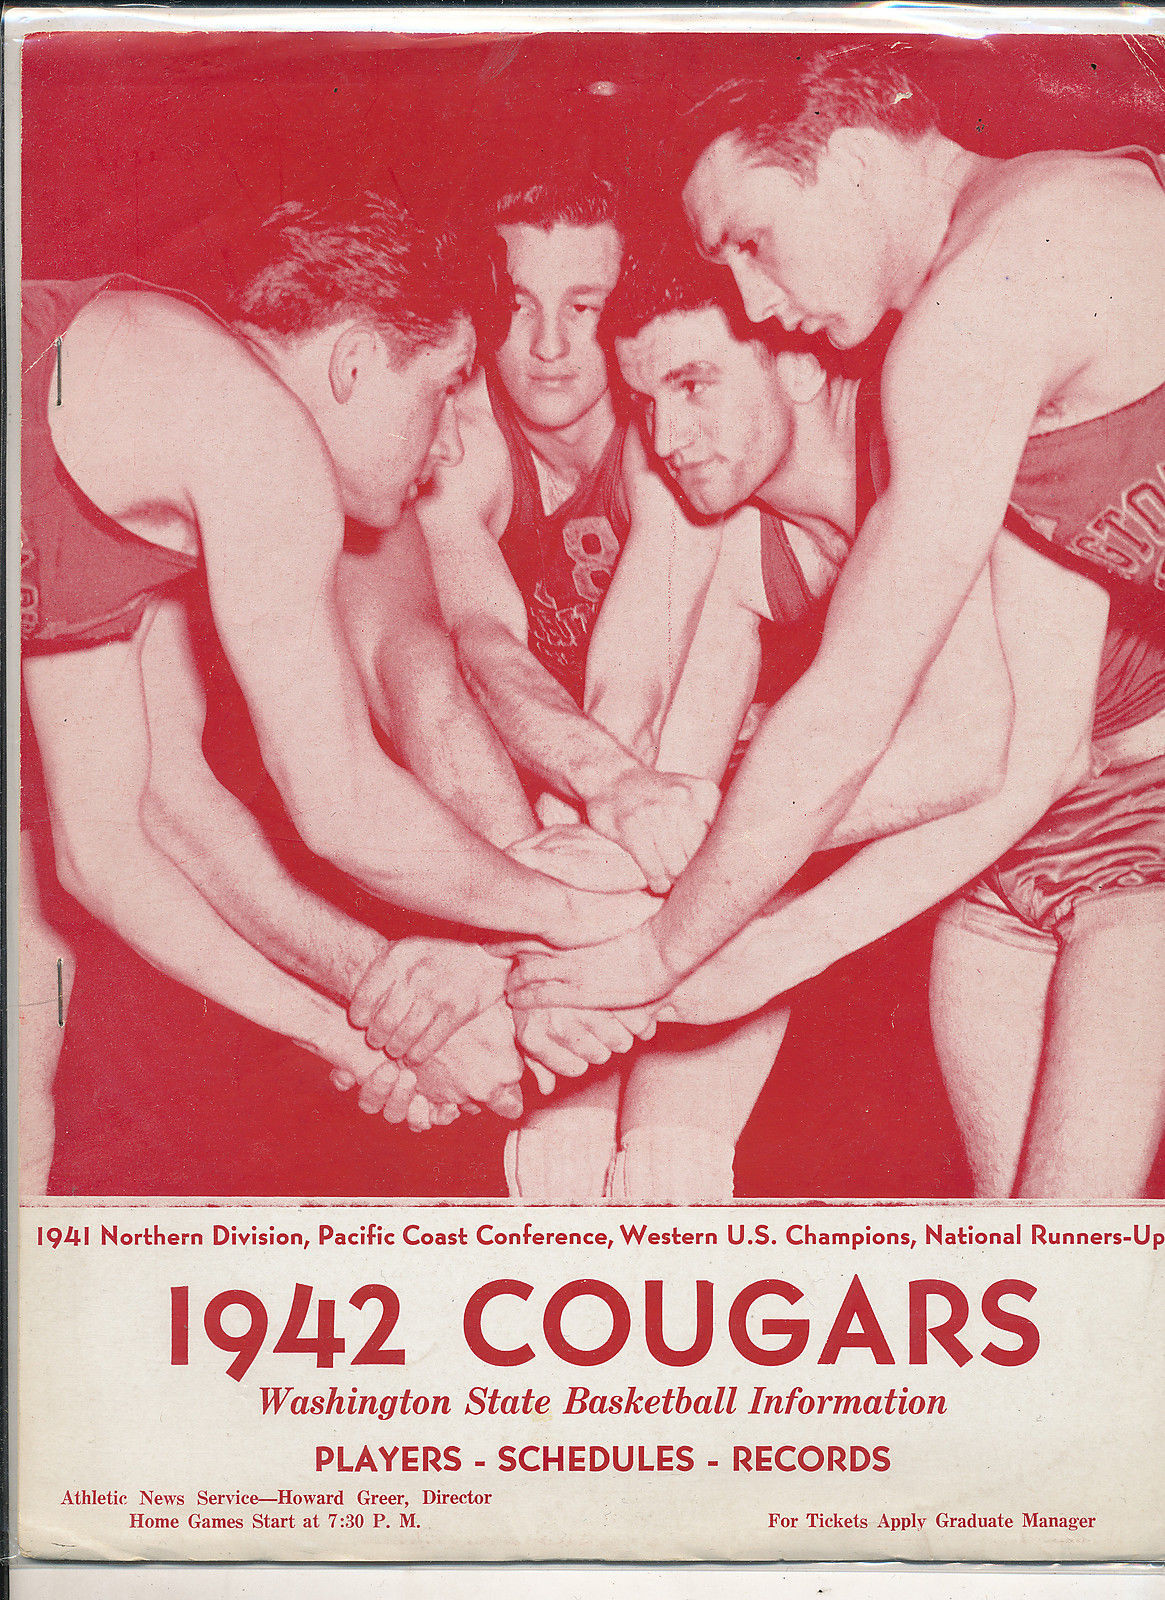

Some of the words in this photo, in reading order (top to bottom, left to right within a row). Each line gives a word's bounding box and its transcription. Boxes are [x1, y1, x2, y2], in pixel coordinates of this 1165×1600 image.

[562, 515, 620, 603] 8
[37, 1225, 90, 1250] 1941
[101, 1223, 204, 1247] Northern
[212, 1224, 311, 1251] Division,
[318, 1223, 396, 1246] Pacific
[402, 1224, 469, 1246] Coast
[476, 1222, 614, 1250] Conference,
[619, 1223, 718, 1246] Western
[727, 1223, 777, 1246] U.S.
[785, 1223, 917, 1251] Champions,
[925, 1223, 1022, 1246] National
[1031, 1223, 1165, 1251] Runners-Up
[170, 1282, 406, 1383] 1942
[463, 1273, 1041, 1369] COUGARS
[259, 1386, 451, 1421] Washington
[464, 1386, 551, 1416] State
[561, 1385, 738, 1415] Basketball
[746, 1386, 948, 1416] Information
[315, 1444, 462, 1473] PLAYERS
[497, 1445, 695, 1473] SCHEDULES
[732, 1445, 892, 1473] RECORDS
[60, 1489, 128, 1506] Athletic
[139, 1489, 185, 1506] News
[356, 1489, 409, 1509] Greer,
[421, 1489, 493, 1505] Director
[128, 1513, 180, 1529] Home
[187, 1513, 244, 1529] Games
[252, 1513, 296, 1529] Start
[302, 1513, 320, 1529] at
[328, 1513, 365, 1529] 7:30
[372, 1512, 391, 1529] P.
[399, 1512, 421, 1529] M.
[767, 1512, 799, 1529] For
[805, 1512, 869, 1529] Tickets
[877, 1512, 927, 1532] Apply
[935, 1512, 1014, 1529] Graduate
[1021, 1511, 1097, 1532] Manager
